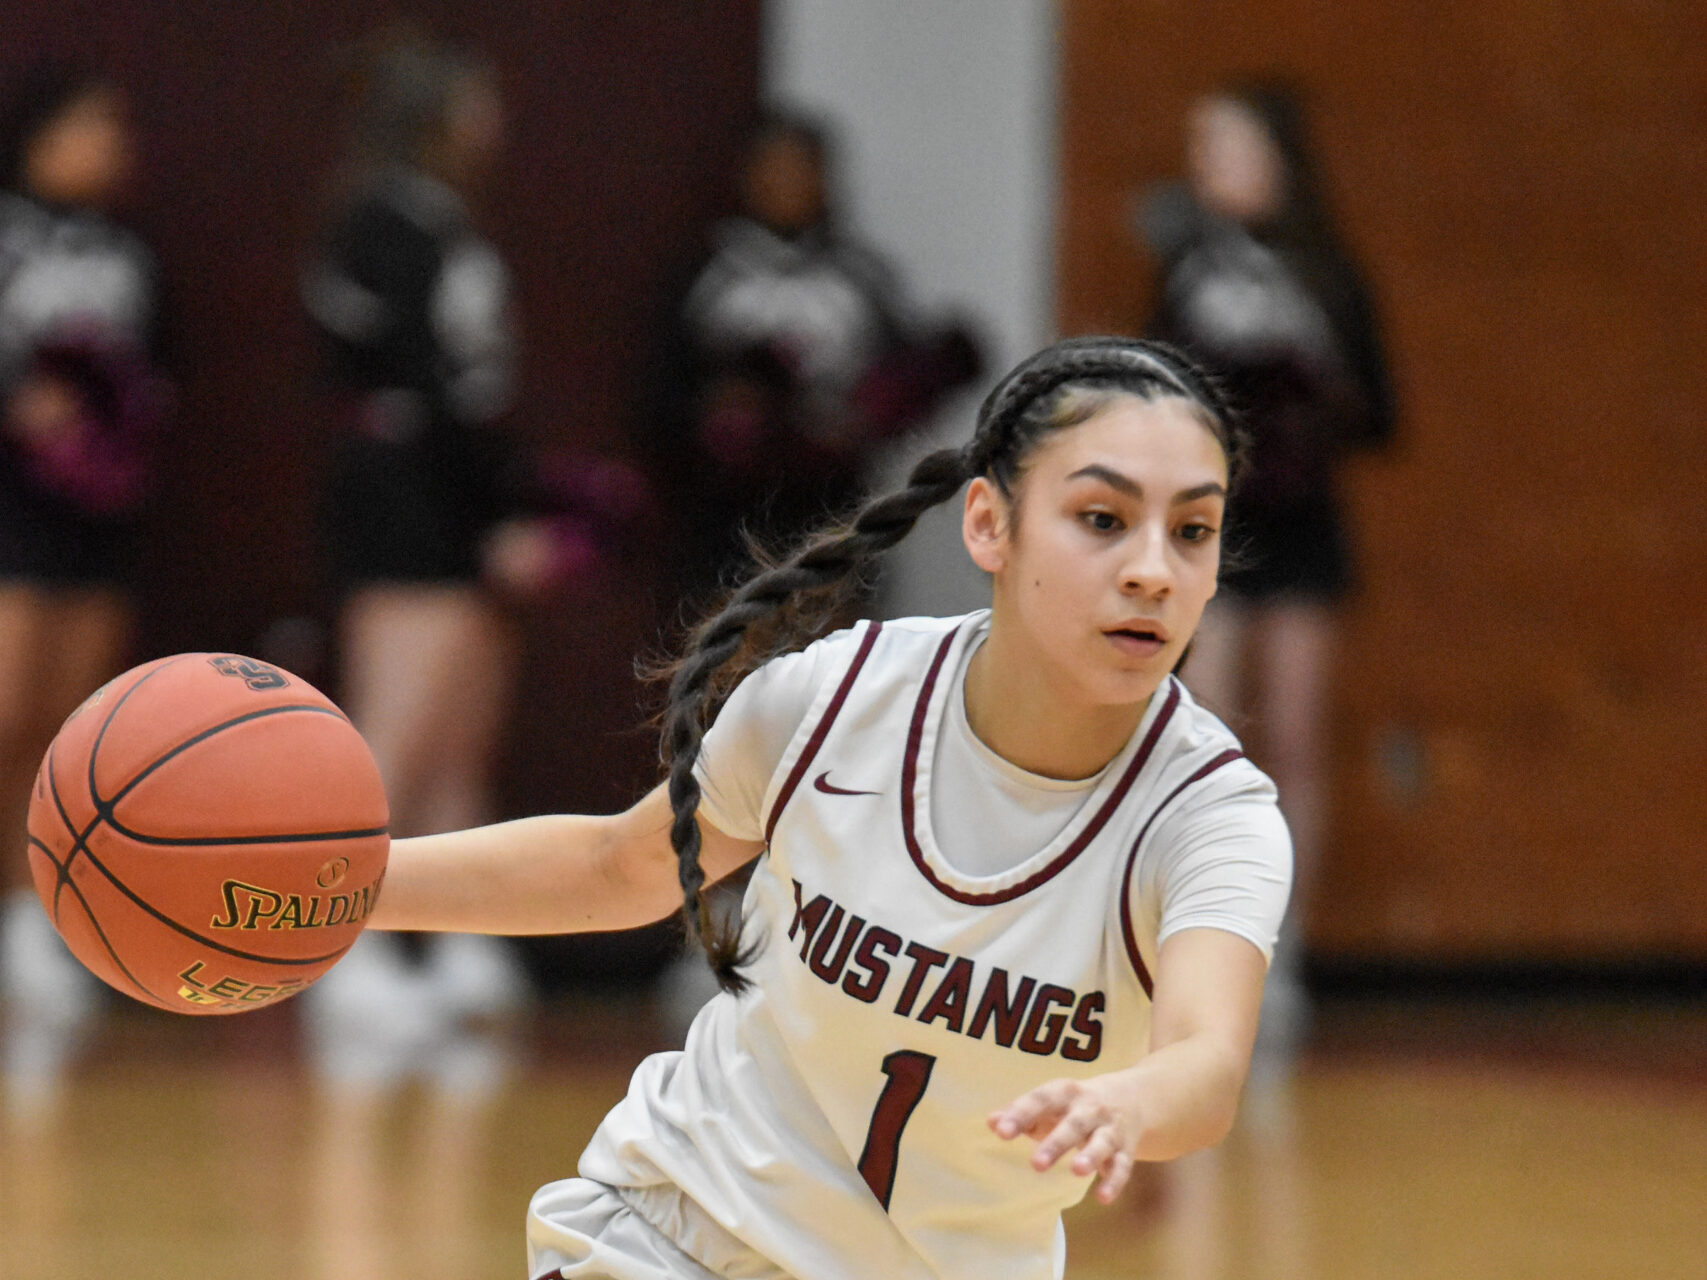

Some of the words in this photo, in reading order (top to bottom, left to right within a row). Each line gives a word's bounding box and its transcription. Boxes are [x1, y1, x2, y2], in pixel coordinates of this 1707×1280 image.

[210, 867, 386, 930] SPALDIN
[788, 878, 1105, 1062] MUSTANGS
[857, 1049, 937, 1214] 1
